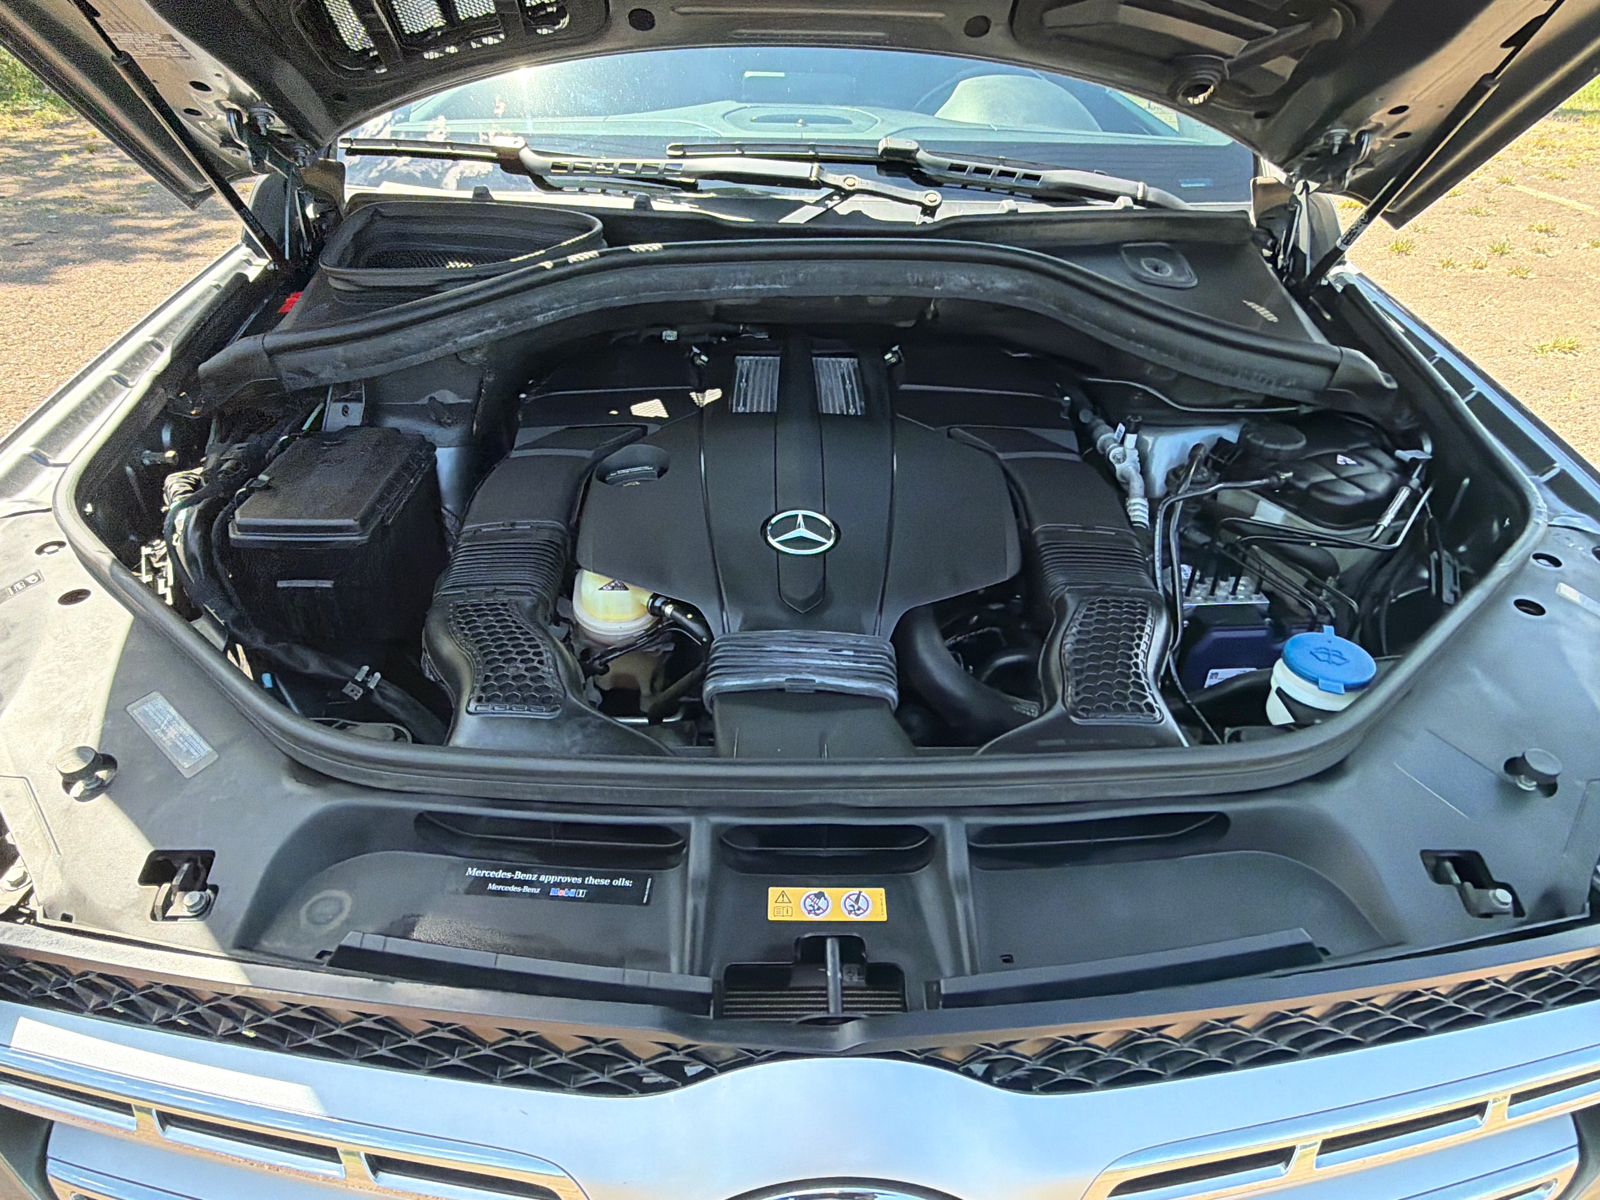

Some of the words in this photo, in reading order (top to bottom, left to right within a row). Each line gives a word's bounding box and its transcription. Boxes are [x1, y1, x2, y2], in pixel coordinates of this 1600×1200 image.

[465, 867, 538, 881] Mercedes-Benz
[539, 875, 582, 884] approves
[584, 876, 610, 886] these
[612, 878, 633, 887] oils:
[487, 883, 541, 894] Mercedes-Benz
